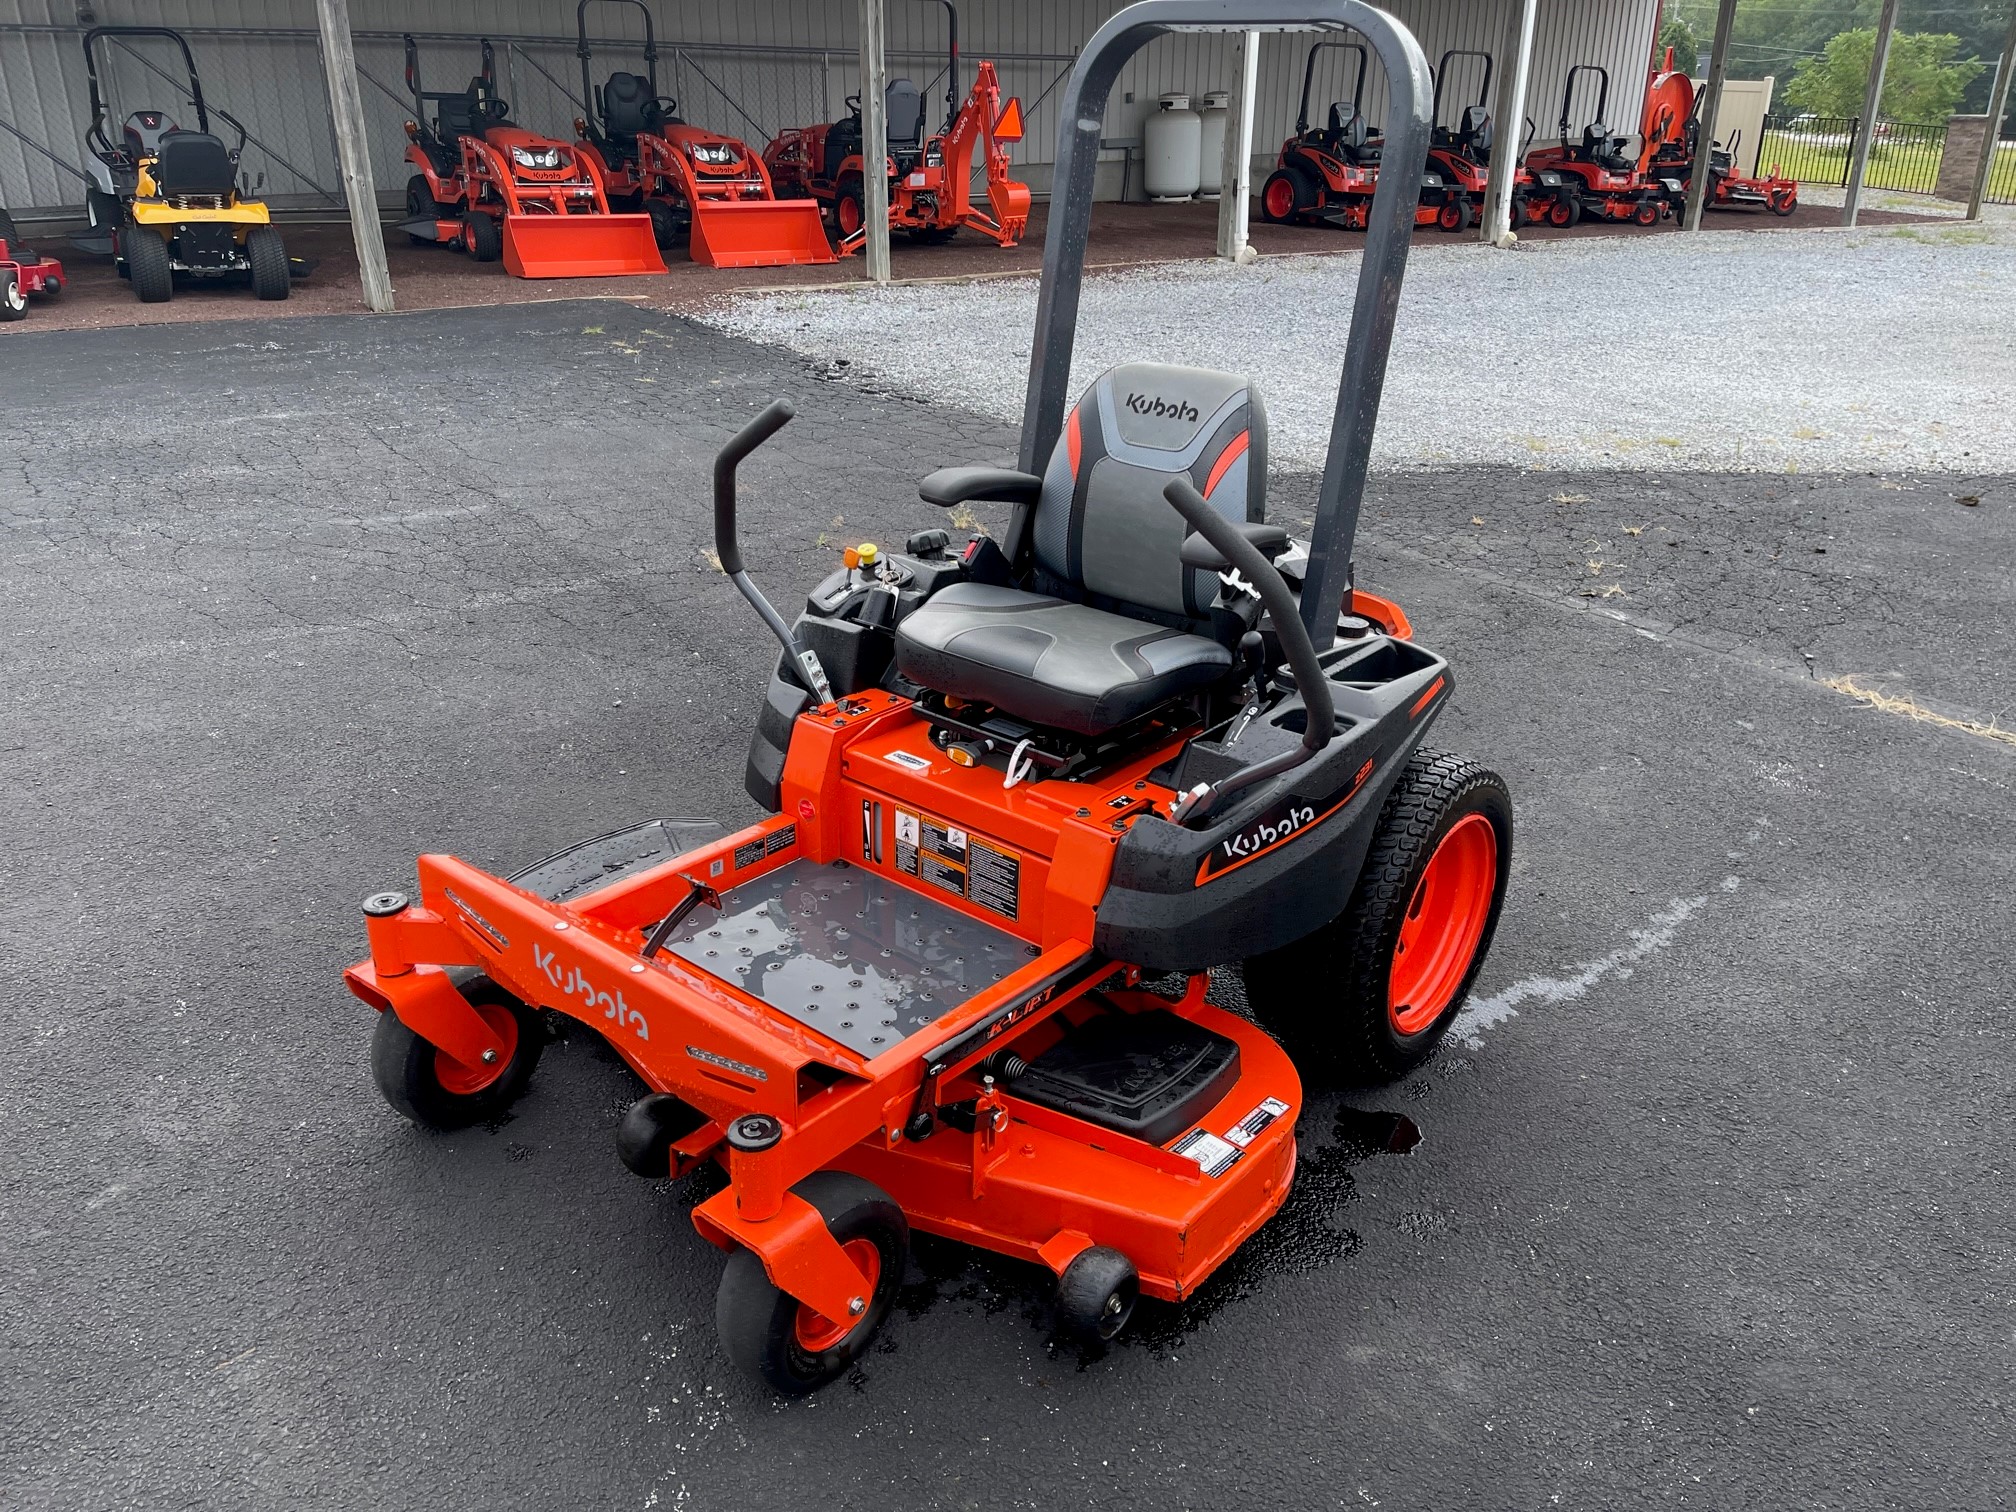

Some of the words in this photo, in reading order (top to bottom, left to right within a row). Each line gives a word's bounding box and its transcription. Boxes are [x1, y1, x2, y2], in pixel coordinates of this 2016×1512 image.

[951, 115, 969, 145] Kubota
[532, 171, 561, 180] Kubota
[709, 166, 735, 174] Kubota
[1126, 393, 1199, 422] Kubota
[864, 801, 870, 809] F
[1223, 806, 1315, 857] Kubota
[865, 851, 871, 860] E
[534, 943, 649, 1041] Kubota
[988, 984, 1056, 1039] K-LIFT
